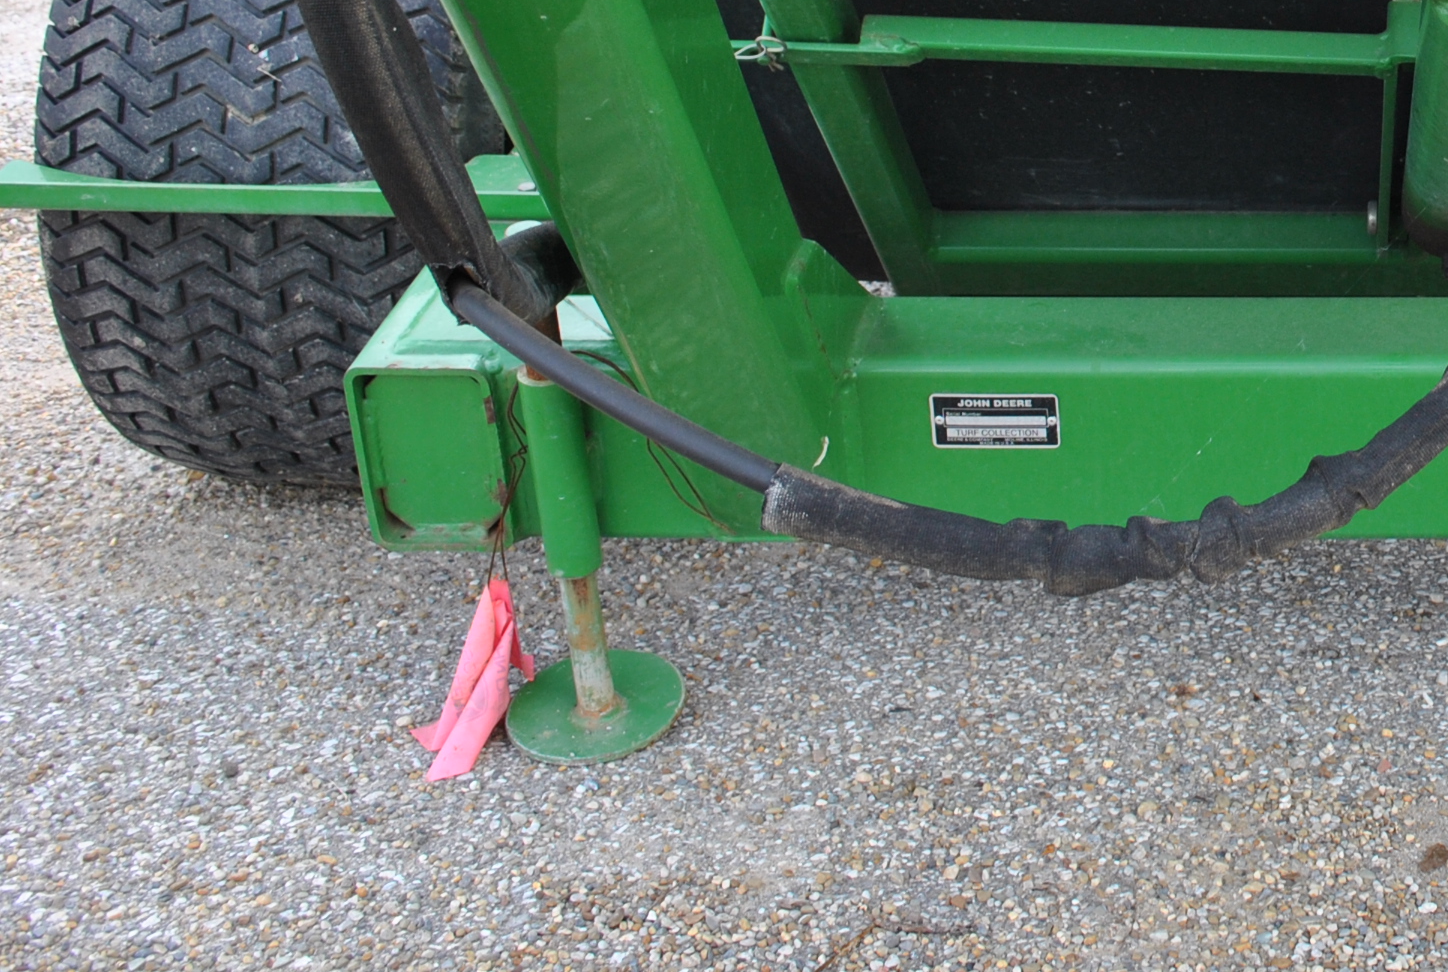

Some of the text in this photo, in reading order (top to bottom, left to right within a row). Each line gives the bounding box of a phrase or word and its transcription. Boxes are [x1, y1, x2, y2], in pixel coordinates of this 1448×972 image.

[957, 399, 1032, 408] JOHN DEERE
[956, 429, 1039, 437] TURF COLLECTION
